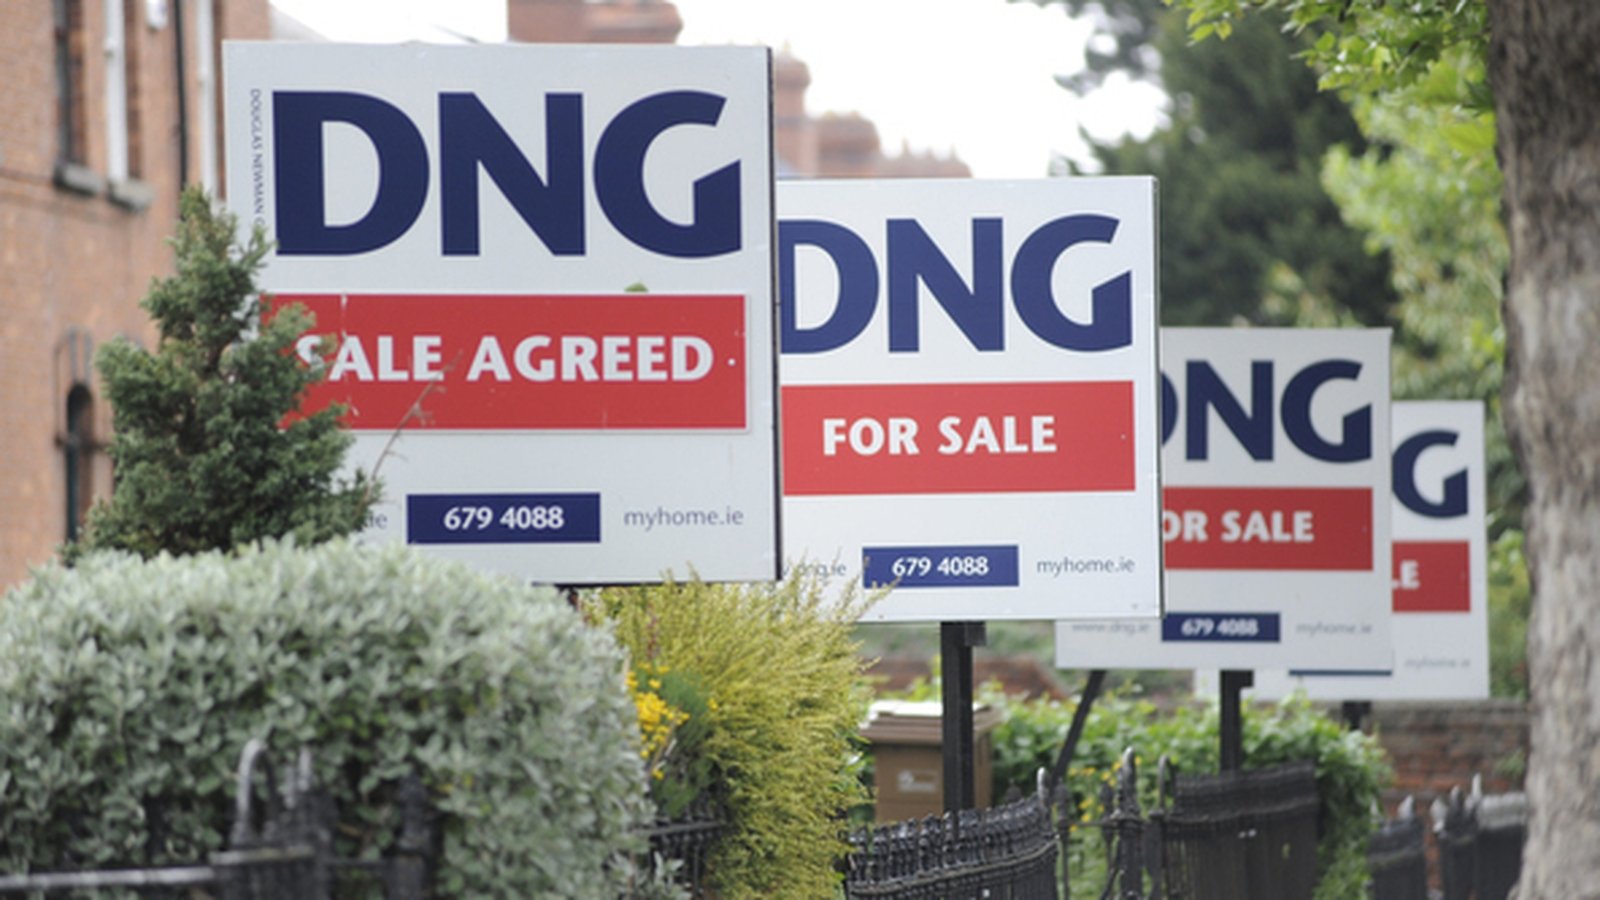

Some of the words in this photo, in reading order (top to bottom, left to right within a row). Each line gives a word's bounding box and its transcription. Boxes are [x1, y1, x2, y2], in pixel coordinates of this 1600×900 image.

[251, 89, 263, 149] DOUGLAS
[253, 153, 265, 213] NEWMAN
[272, 90, 742, 258] DNG
[777, 213, 1133, 354] DNG
[466, 335, 713, 381] AGREED
[1161, 358, 1373, 464] NG
[822, 417, 920, 456] FOR
[937, 415, 1058, 454] SALE
[443, 506, 494, 530] 679
[499, 505, 565, 529] 4088
[623, 503, 745, 531] myhome.ie
[1220, 510, 1315, 542] SALE
[891, 557, 931, 577] 679
[936, 556, 990, 576] 4088
[1036, 555, 1136, 575] myhome.ie
[1181, 618, 1214, 637] 679
[1216, 618, 1259, 637] 4088
